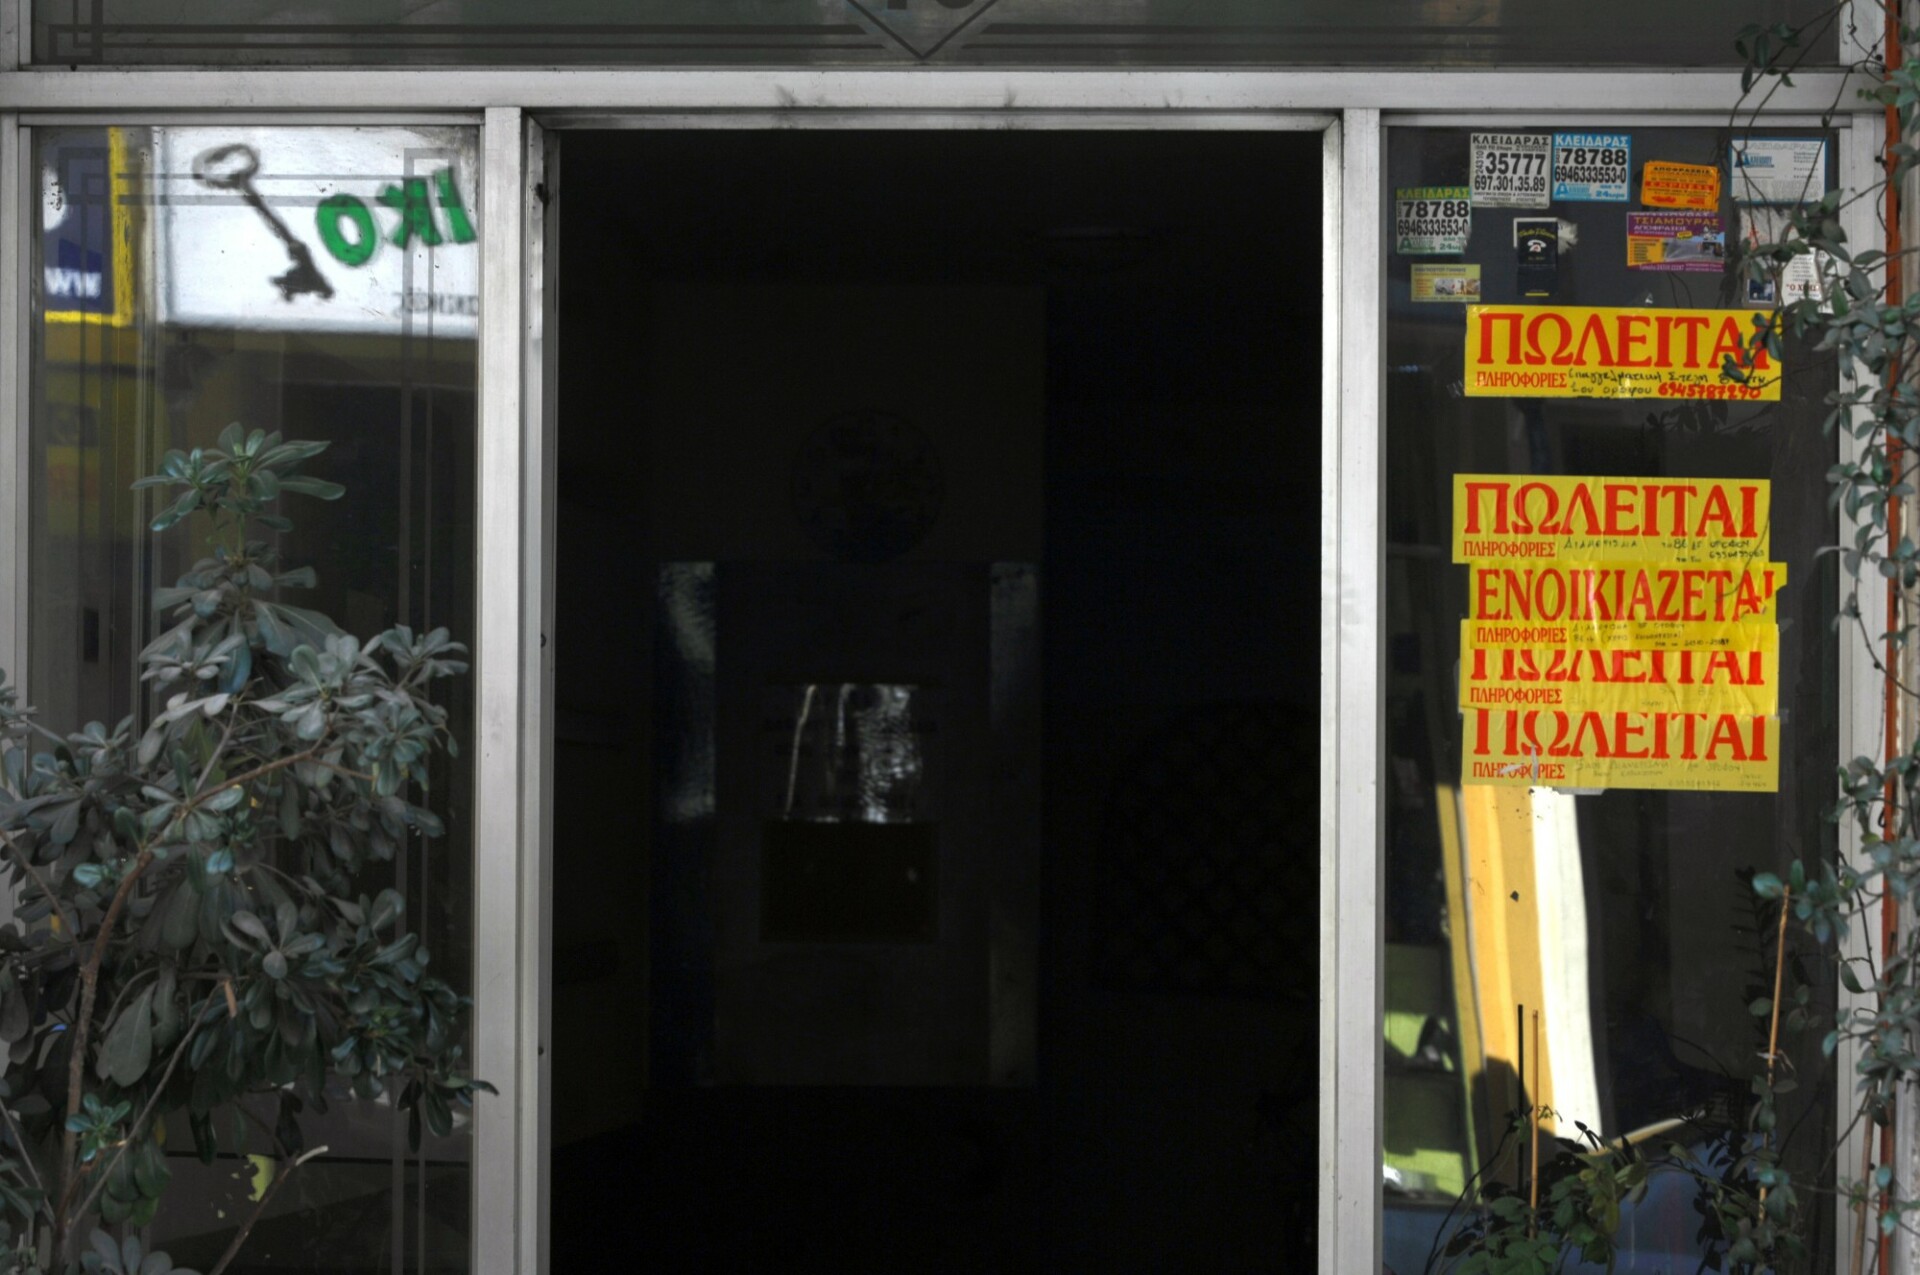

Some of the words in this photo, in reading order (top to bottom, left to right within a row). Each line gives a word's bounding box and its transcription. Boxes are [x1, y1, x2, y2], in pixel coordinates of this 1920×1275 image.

[1472, 135, 1549, 146] ΚΛΕΙΔΑΡΑΣ
[1556, 135, 1628, 147] ΚΛΕΙΔΑΡΑΣ
[1485, 152, 1546, 175] 35777
[1561, 148, 1626, 165] 78788
[1475, 175, 1545, 192] 697.301.35.89
[1396, 188, 1469, 199] ΚΛΕΙΔΑΡΑΣ
[1402, 201, 1469, 218] 78788
[1476, 371, 1568, 389] ΠΛΗΡΟΦΟΡΙΕΣ
[1464, 482, 1758, 538] ΠΩΛΕΙΤΑΙ
[1464, 541, 1556, 558] ΠΛΗΡΟΦΟΡΙΕΣ
[1476, 568, 1775, 622] ΕΝΟΙΚΙΑΖΕΤΑΙ
[1477, 627, 1567, 644] ΠΛΗΡΟΦΟΡΙΕΣ
[1470, 687, 1563, 704] ΠΛΗΡΟΦΟΡΙΕΣ
[1473, 708, 1768, 762] ΠΩΛΕΙΤΑΙ
